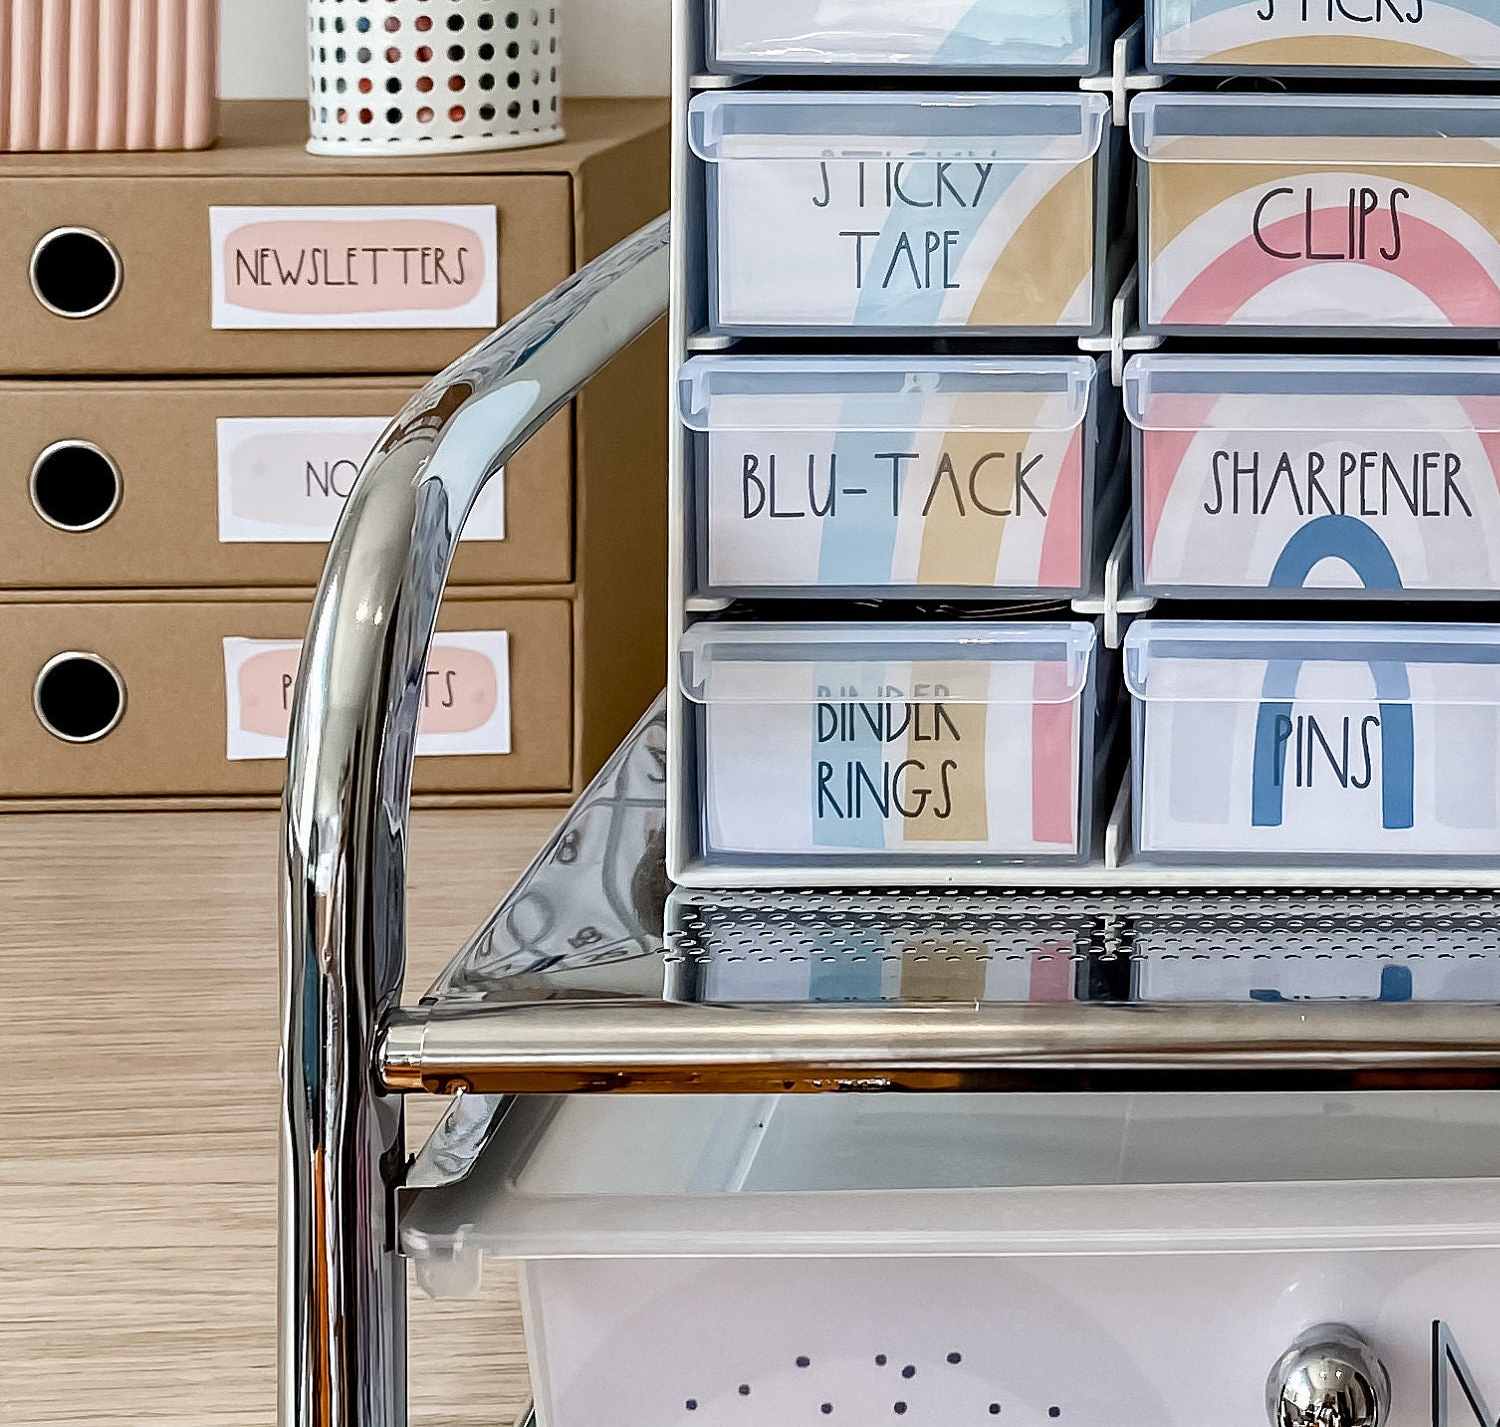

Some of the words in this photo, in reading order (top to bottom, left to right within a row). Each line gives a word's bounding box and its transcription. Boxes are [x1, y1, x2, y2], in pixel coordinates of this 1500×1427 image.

[813, 149, 998, 209] STICKY
[1252, 186, 1410, 261] CLIPS
[235, 246, 468, 286] NEWSLETTERS
[839, 230, 961, 290] TAPE
[742, 451, 1048, 520] BLU-TACK
[1203, 450, 1473, 518] SHARPENER
[817, 684, 961, 743] BINDER
[1274, 714, 1380, 790] PINS
[817, 759, 958, 819] RINGS
